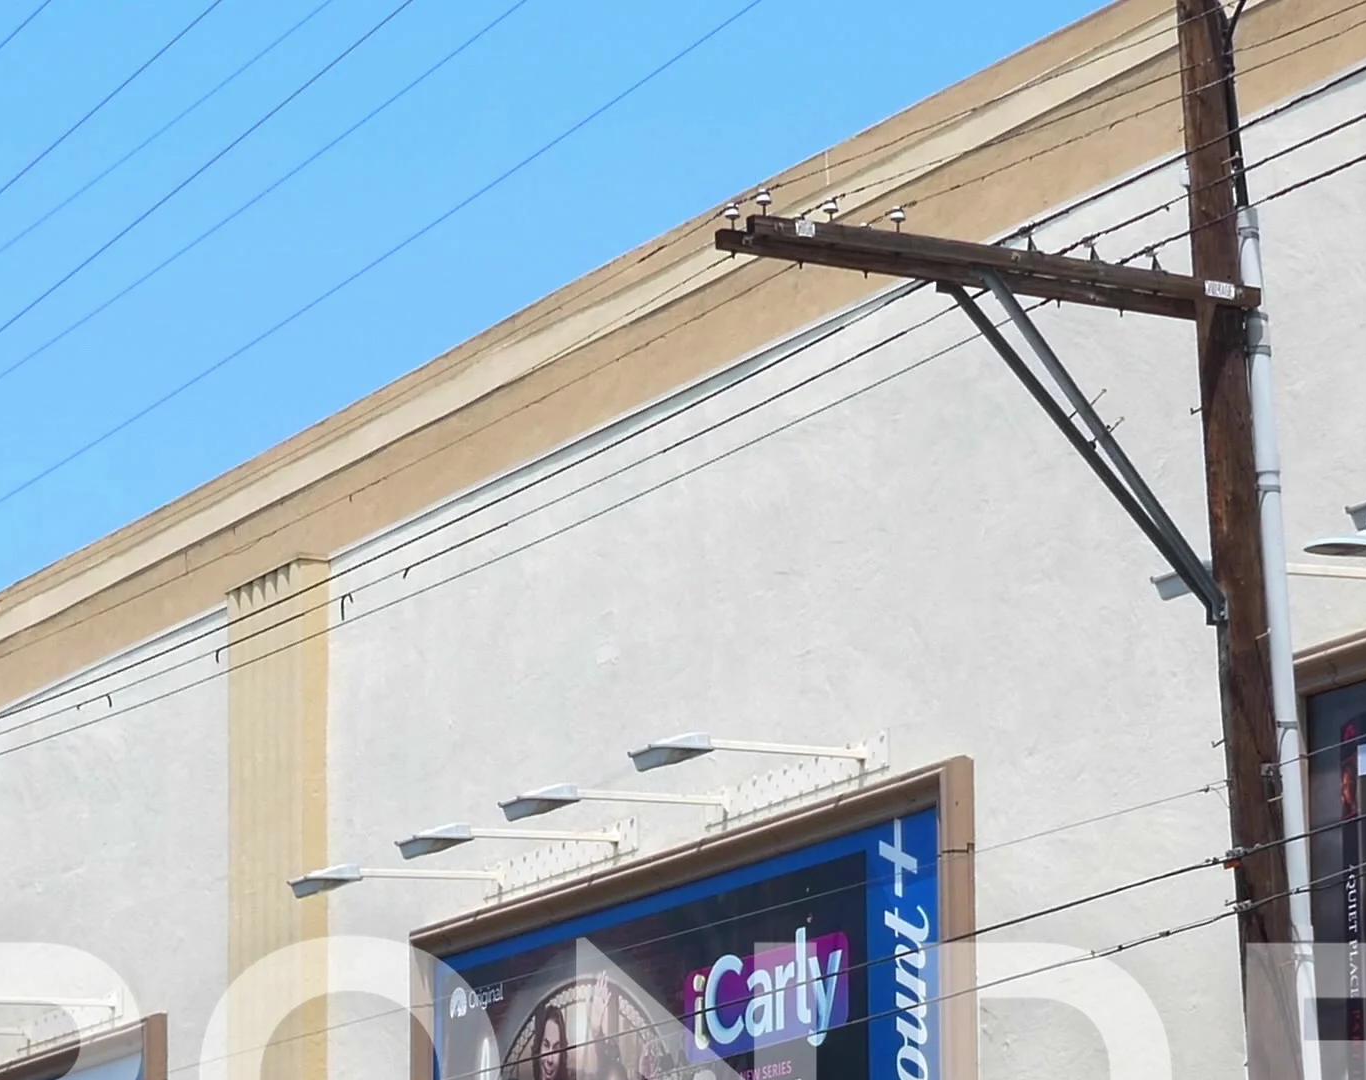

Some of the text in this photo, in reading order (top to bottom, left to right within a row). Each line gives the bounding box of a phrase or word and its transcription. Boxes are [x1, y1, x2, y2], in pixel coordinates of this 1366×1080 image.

[1346, 873, 1358, 933] QUIET
[468, 983, 504, 1010] Original
[693, 927, 843, 1049] iCarly
[1349, 940, 1360, 999] PLACE
[762, 1061, 793, 1080] SERIES
